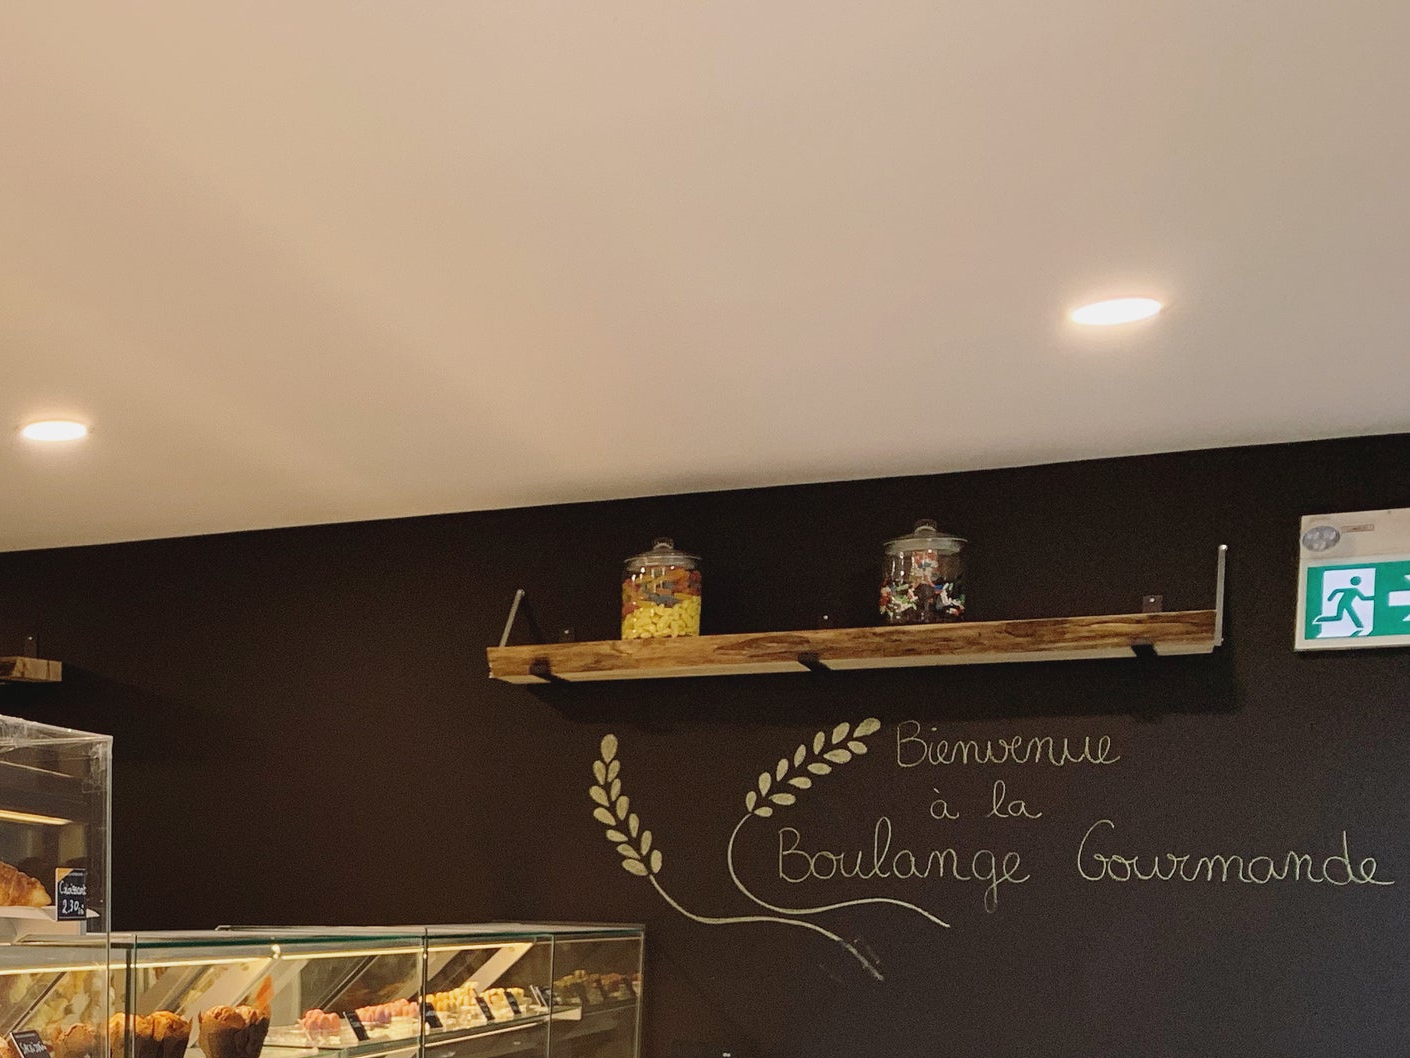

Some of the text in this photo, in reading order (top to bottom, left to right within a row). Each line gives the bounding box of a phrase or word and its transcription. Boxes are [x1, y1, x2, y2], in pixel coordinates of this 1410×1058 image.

[895, 719, 1121, 769] Bienvenue
[929, 779, 1043, 820] à la
[776, 816, 1396, 913] Boulange Gourmande
